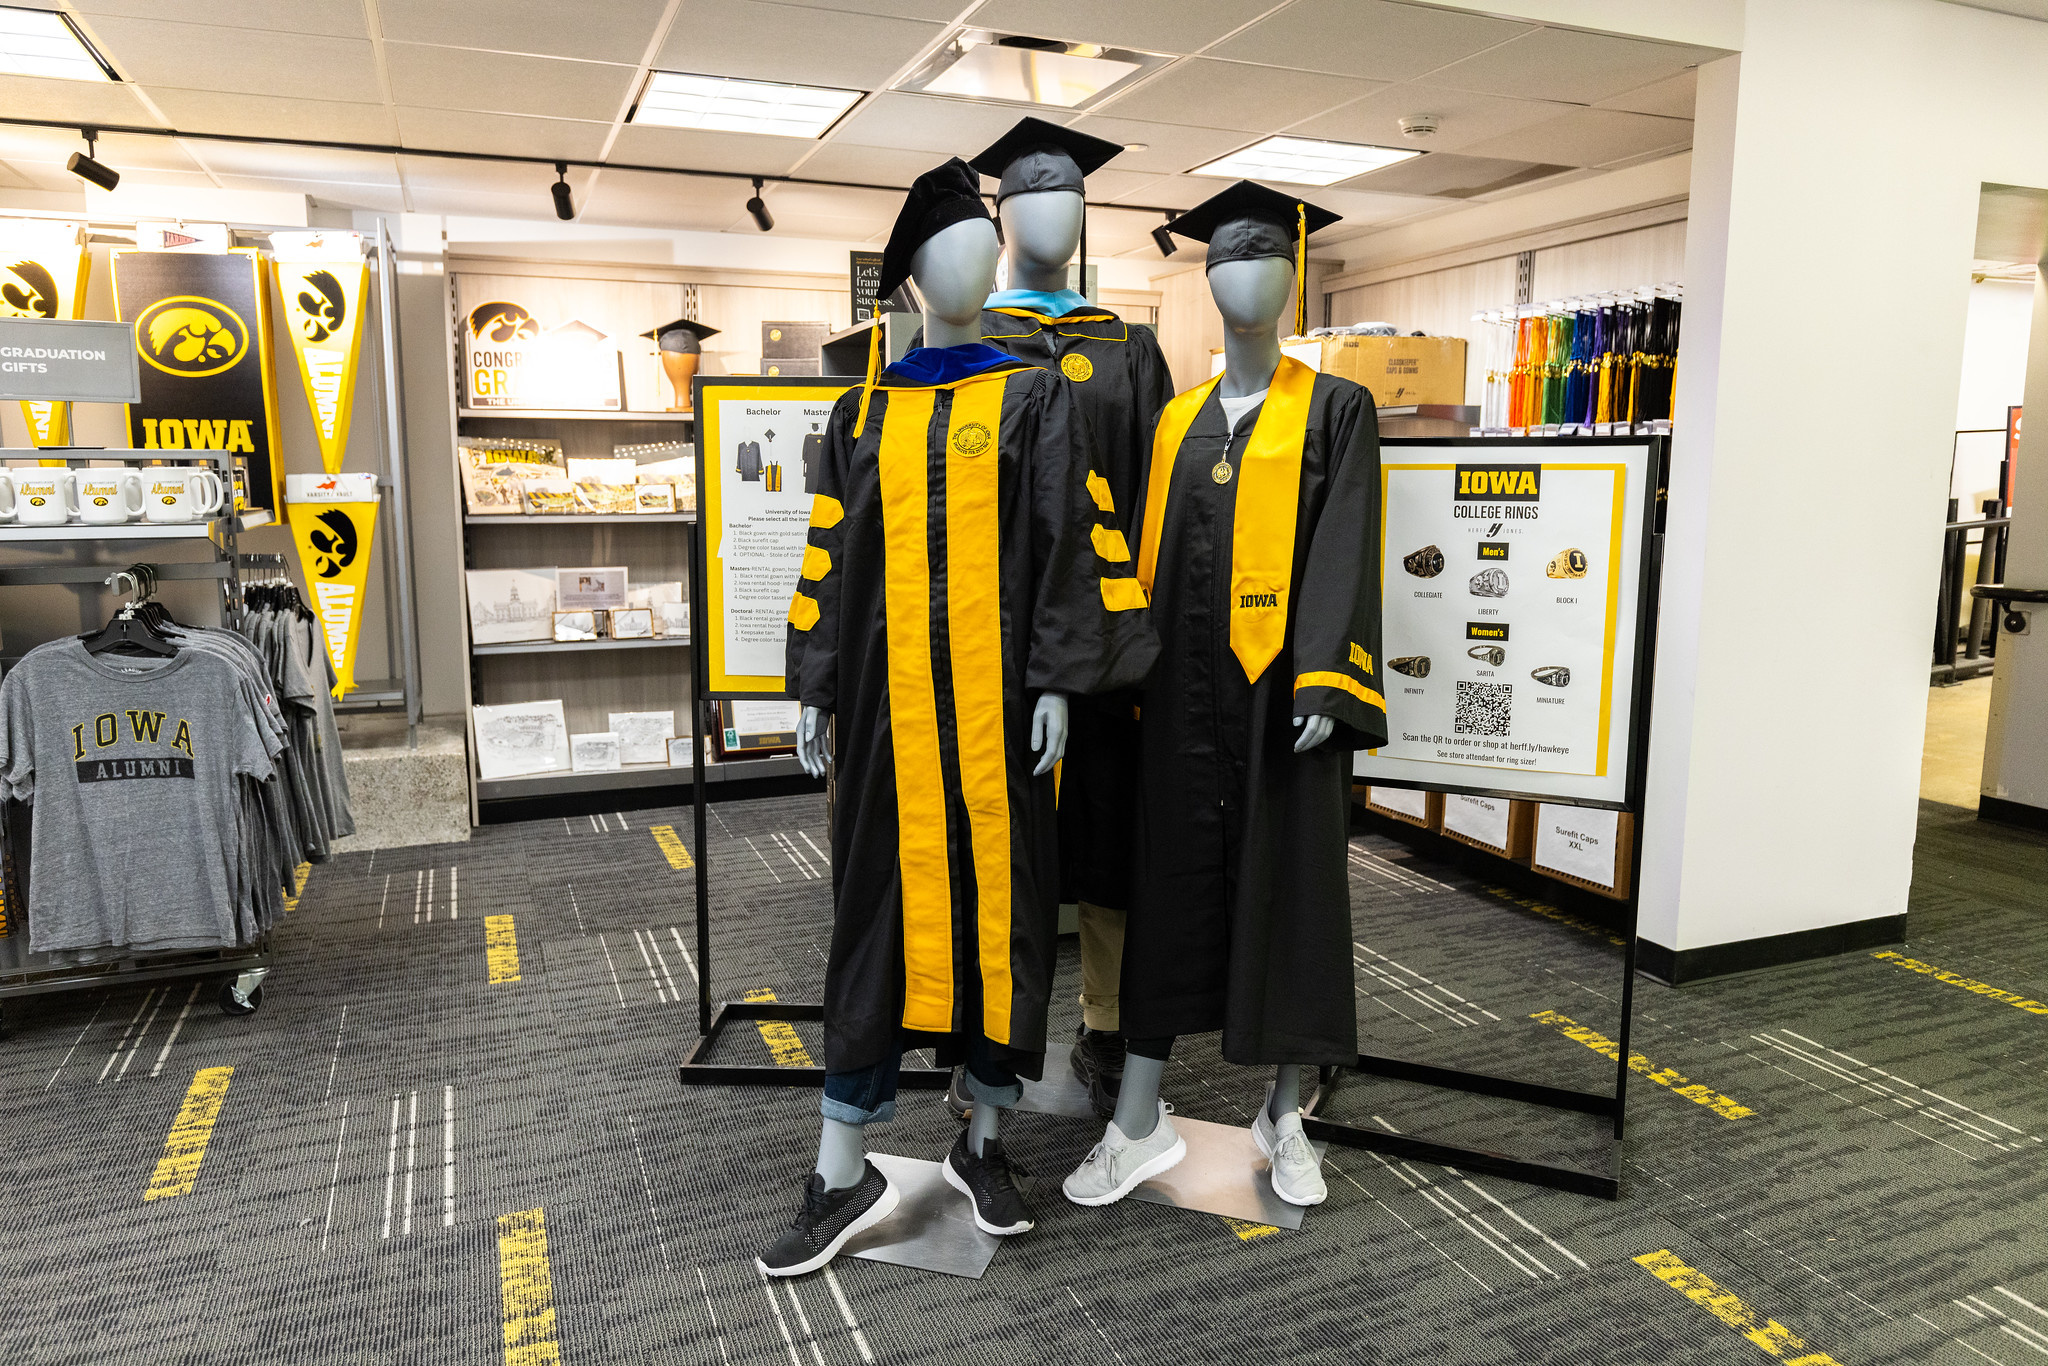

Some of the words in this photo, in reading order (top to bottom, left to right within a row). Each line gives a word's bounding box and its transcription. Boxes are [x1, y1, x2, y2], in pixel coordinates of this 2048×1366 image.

[857, 266, 879, 277] Let's
[857, 276, 880, 287] fram
[857, 288, 879, 298] your
[0, 346, 106, 361] GRADUATION
[1, 361, 48, 374] GIFTS
[746, 407, 781, 415] Bachelor
[142, 418, 255, 453] IOWA
[484, 449, 541, 465] IOWA
[19, 483, 56, 496] Alumni
[83, 483, 118, 496] Alumni
[151, 482, 185, 495] Alumni
[1459, 471, 1538, 495] IOWA
[1453, 505, 1502, 519] COLLEGE
[1505, 506, 1539, 519] RINGS
[1482, 547, 1504, 556] Men's
[1240, 593, 1278, 608] IOWA
[1413, 591, 1443, 599] COLLEGIATE
[1556, 596, 1573, 604] BLOCK
[315, 582, 355, 668] ALUMNI
[1471, 627, 1504, 637] Women's
[1349, 641, 1373, 675] IOWA
[1404, 687, 1425, 695] INFINITY
[1536, 697, 1565, 705] MINIATURE
[72, 710, 194, 762] IOWA
[1402, 732, 1419, 742] Scan
[1420, 734, 1432, 743] the
[1433, 735, 1443, 744] QR
[1445, 737, 1452, 745] to
[1453, 738, 1472, 747] order
[1482, 740, 1499, 750] shop
[1500, 742, 1508, 750] at
[1509, 742, 1570, 755] herff.ly/hawkeye
[1437, 749, 1448, 758] See
[1449, 751, 1465, 759] store
[1466, 753, 1495, 762] attendant
[1496, 755, 1505, 763] for
[1506, 757, 1519, 766] ring
[1520, 758, 1537, 766] sizer!
[96, 759, 181, 780] ALUMNI
[1460, 795, 1479, 808] Surefit
[1479, 799, 1495, 811] Caps
[1555, 826, 1579, 839] Surefit
[1580, 833, 1599, 845] Caps
[1568, 840, 1584, 851] XXL
